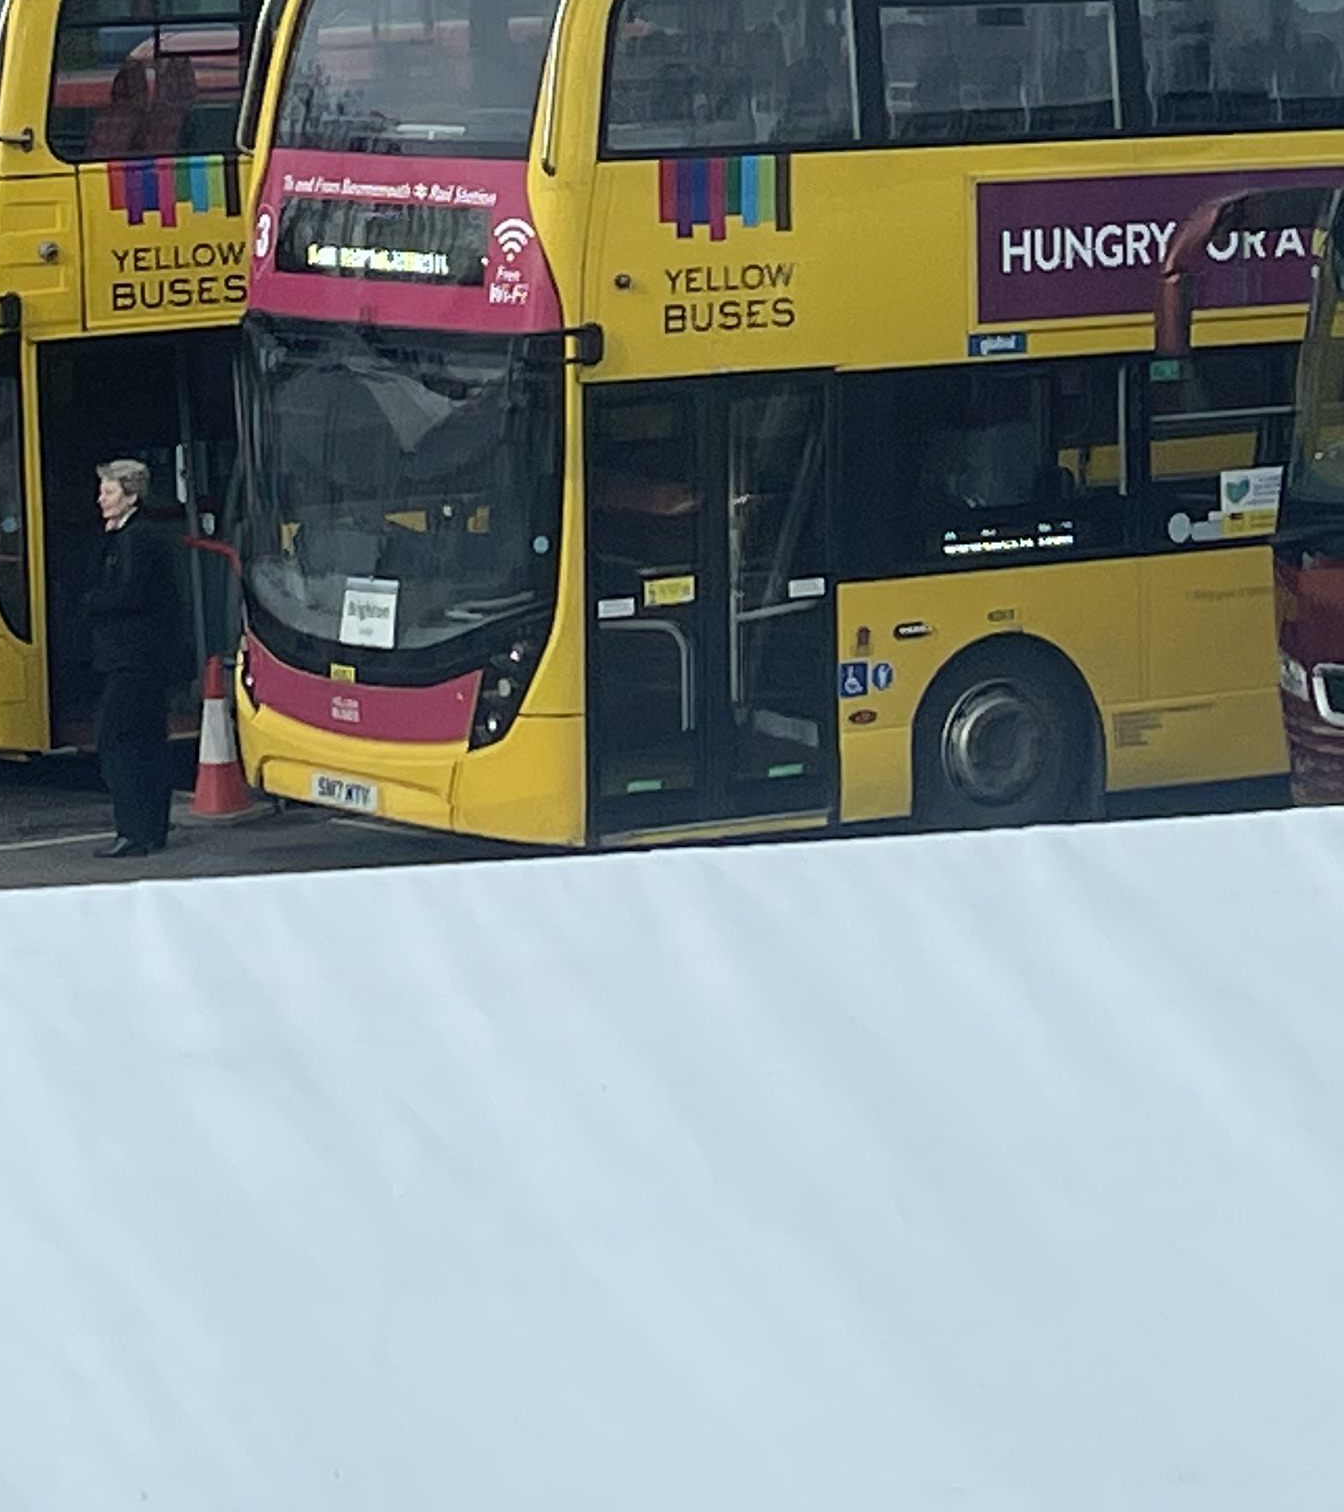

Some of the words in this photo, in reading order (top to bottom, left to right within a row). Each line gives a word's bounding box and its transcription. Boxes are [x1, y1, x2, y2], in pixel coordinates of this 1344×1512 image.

[340, 178, 411, 199] Bournemouth
[429, 183, 454, 203] Rail
[112, 242, 246, 273] YELLOW
[1001, 220, 1176, 274] HUNGRY
[495, 266, 521, 283] Free
[664, 262, 795, 294] YELLOW
[113, 274, 248, 311] BUSES
[664, 297, 796, 334] BUSES
